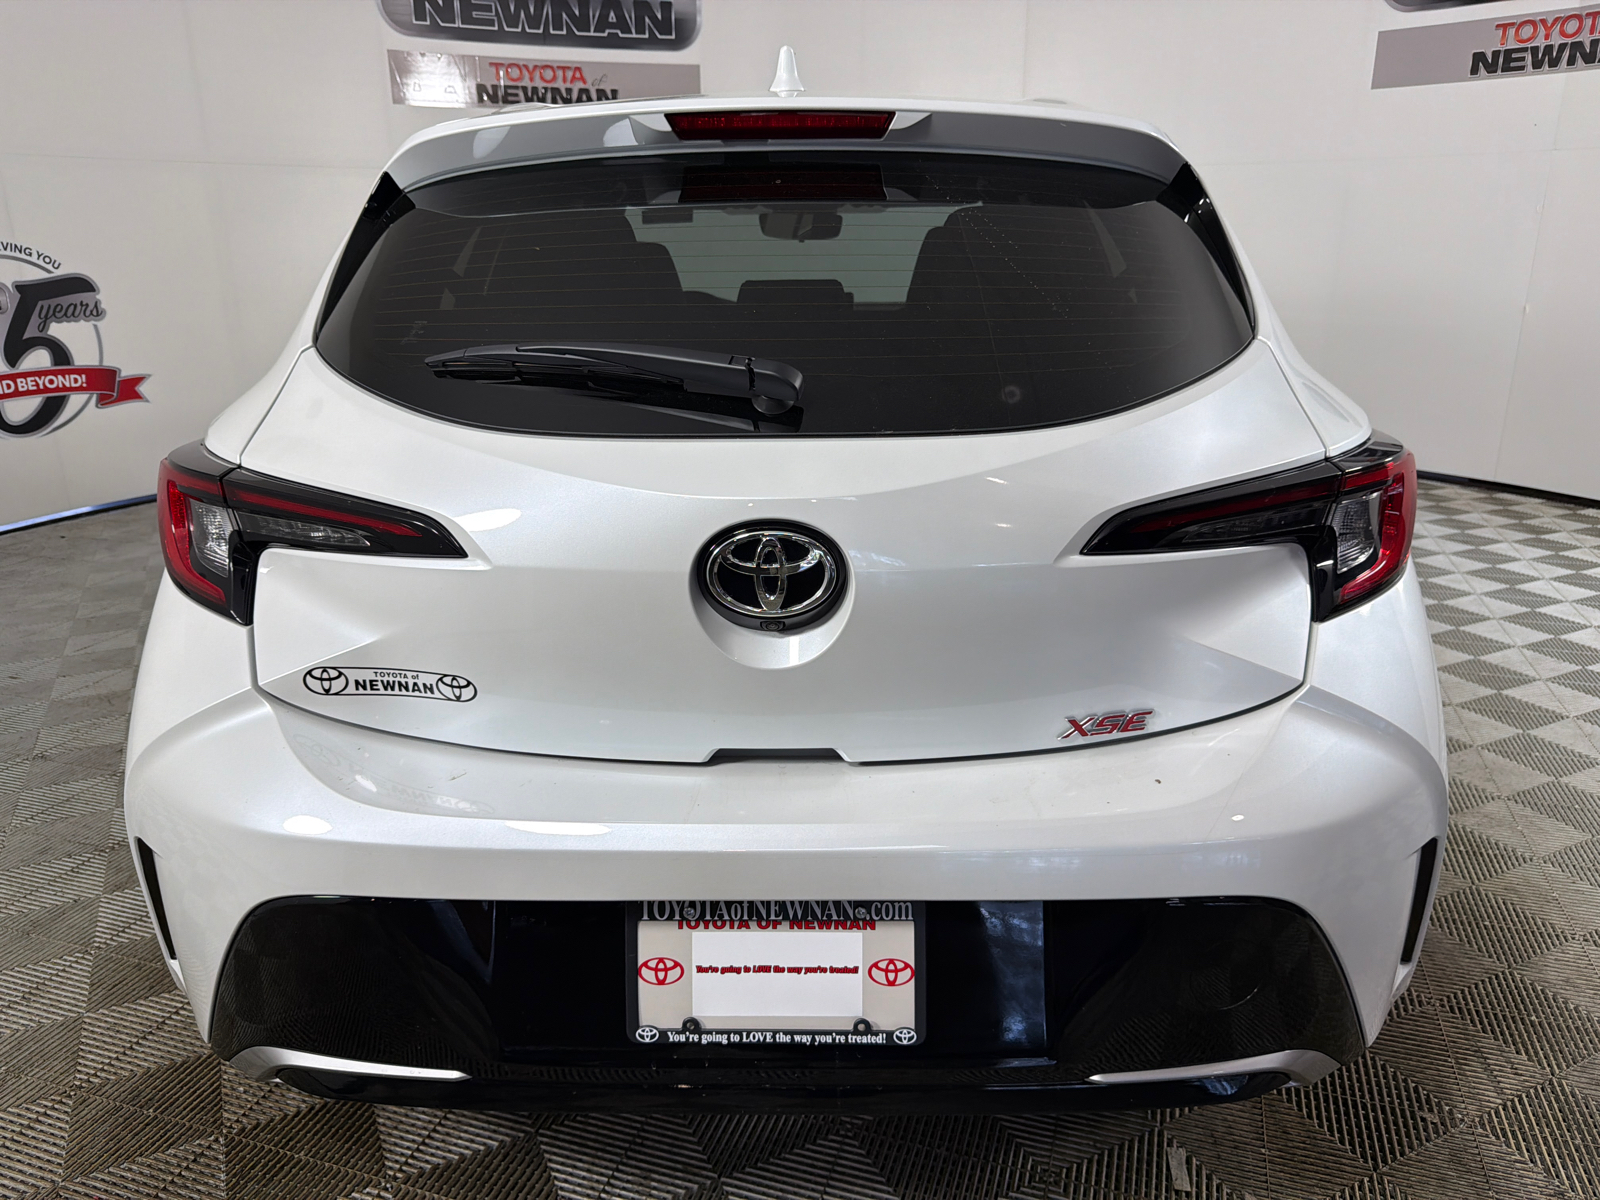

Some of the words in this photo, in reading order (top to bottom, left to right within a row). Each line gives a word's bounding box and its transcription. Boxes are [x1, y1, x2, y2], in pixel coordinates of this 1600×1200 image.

[410, 0, 676, 39] NEWNAN
[1494, 10, 1600, 46] TOYOT
[1468, 37, 1600, 77] NEWN
[489, 61, 588, 85] TOYOTA
[591, 73, 607, 87] of
[474, 83, 619, 105] NEWNAN
[0, 241, 33, 257] VING
[36, 249, 62, 270] YOU
[38, 299, 104, 333] years
[16, 373, 87, 392] BEYOND!
[354, 678, 435, 695] NEWNAN
[373, 671, 409, 680] TOYOTA
[1057, 708, 1155, 740] XSE
[743, 965, 751, 973] to
[752, 965, 772, 973] LOVE
[773, 965, 786, 974] the
[787, 966, 803, 975] way
[667, 1031, 700, 1043] You're
[701, 1031, 728, 1045] going
[730, 1032, 741, 1043] to
[742, 1031, 774, 1043] LOVE
[775, 1032, 792, 1043] the
[793, 1033, 813, 1046] way
[814, 1032, 846, 1046] you're
[848, 1033, 887, 1044] treated!
